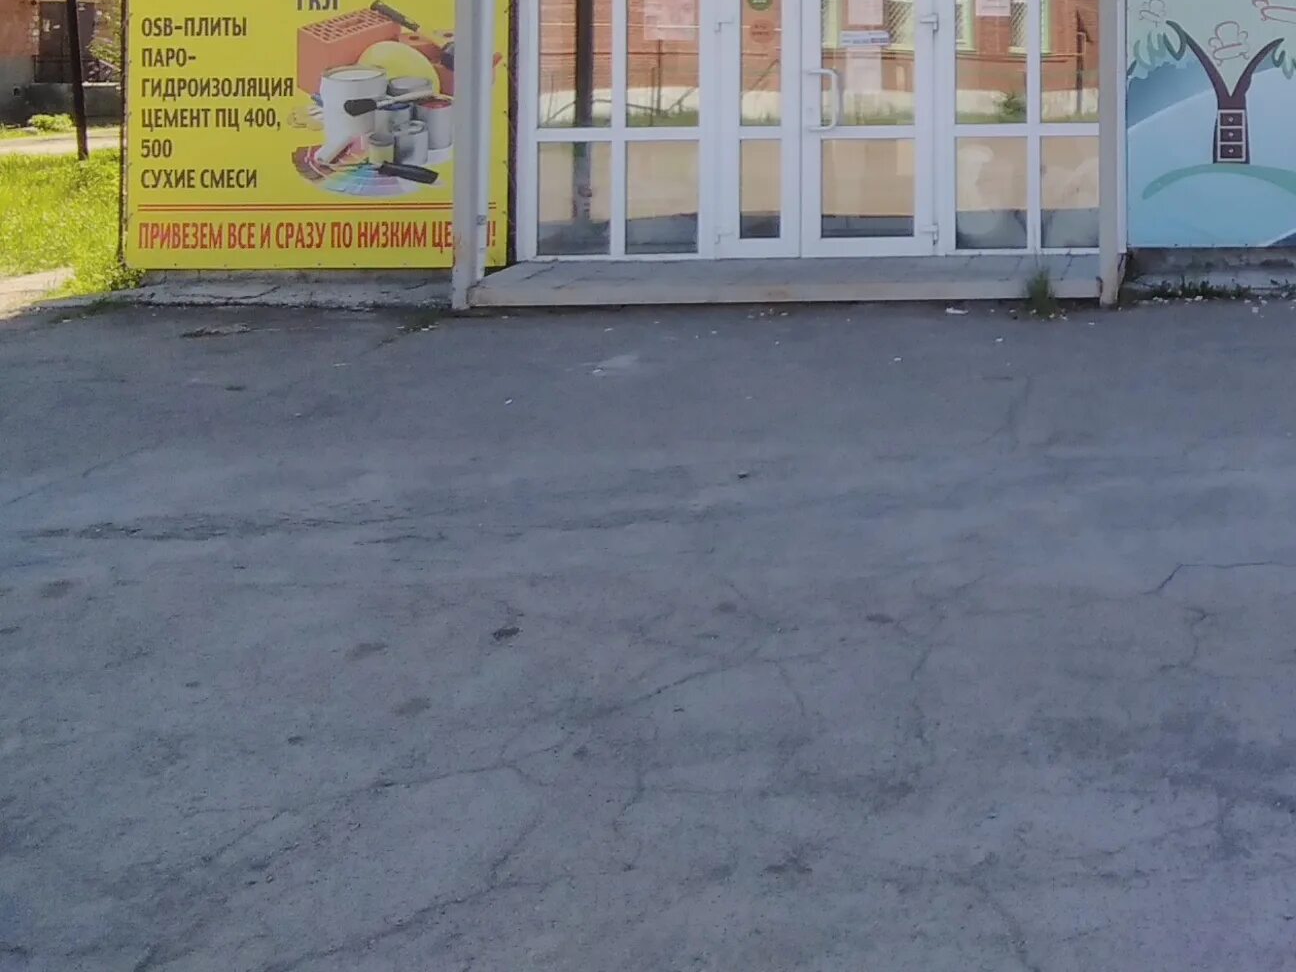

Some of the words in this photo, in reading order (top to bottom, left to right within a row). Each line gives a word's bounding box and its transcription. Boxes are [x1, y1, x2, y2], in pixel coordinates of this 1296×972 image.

[141, 48, 197, 68] ПАРО-
[141, 77, 294, 102] ГИДРОИЗОЛЯЦИЯ
[141, 108, 212, 132] ЦЕМЕНТ
[215, 108, 240, 131] ПЦ
[244, 108, 281, 130] 400,
[140, 139, 173, 159] 500
[140, 169, 196, 189] СУХИЕ
[200, 169, 258, 189] СМЕСИ
[138, 222, 224, 250] ПРИВЕЗЕМ
[227, 222, 256, 249] ВСЕ
[259, 222, 272, 249] И
[275, 221, 326, 249] СРАЗУ
[330, 221, 353, 249] ПО
[357, 220, 427, 249] НИЗКИМ
